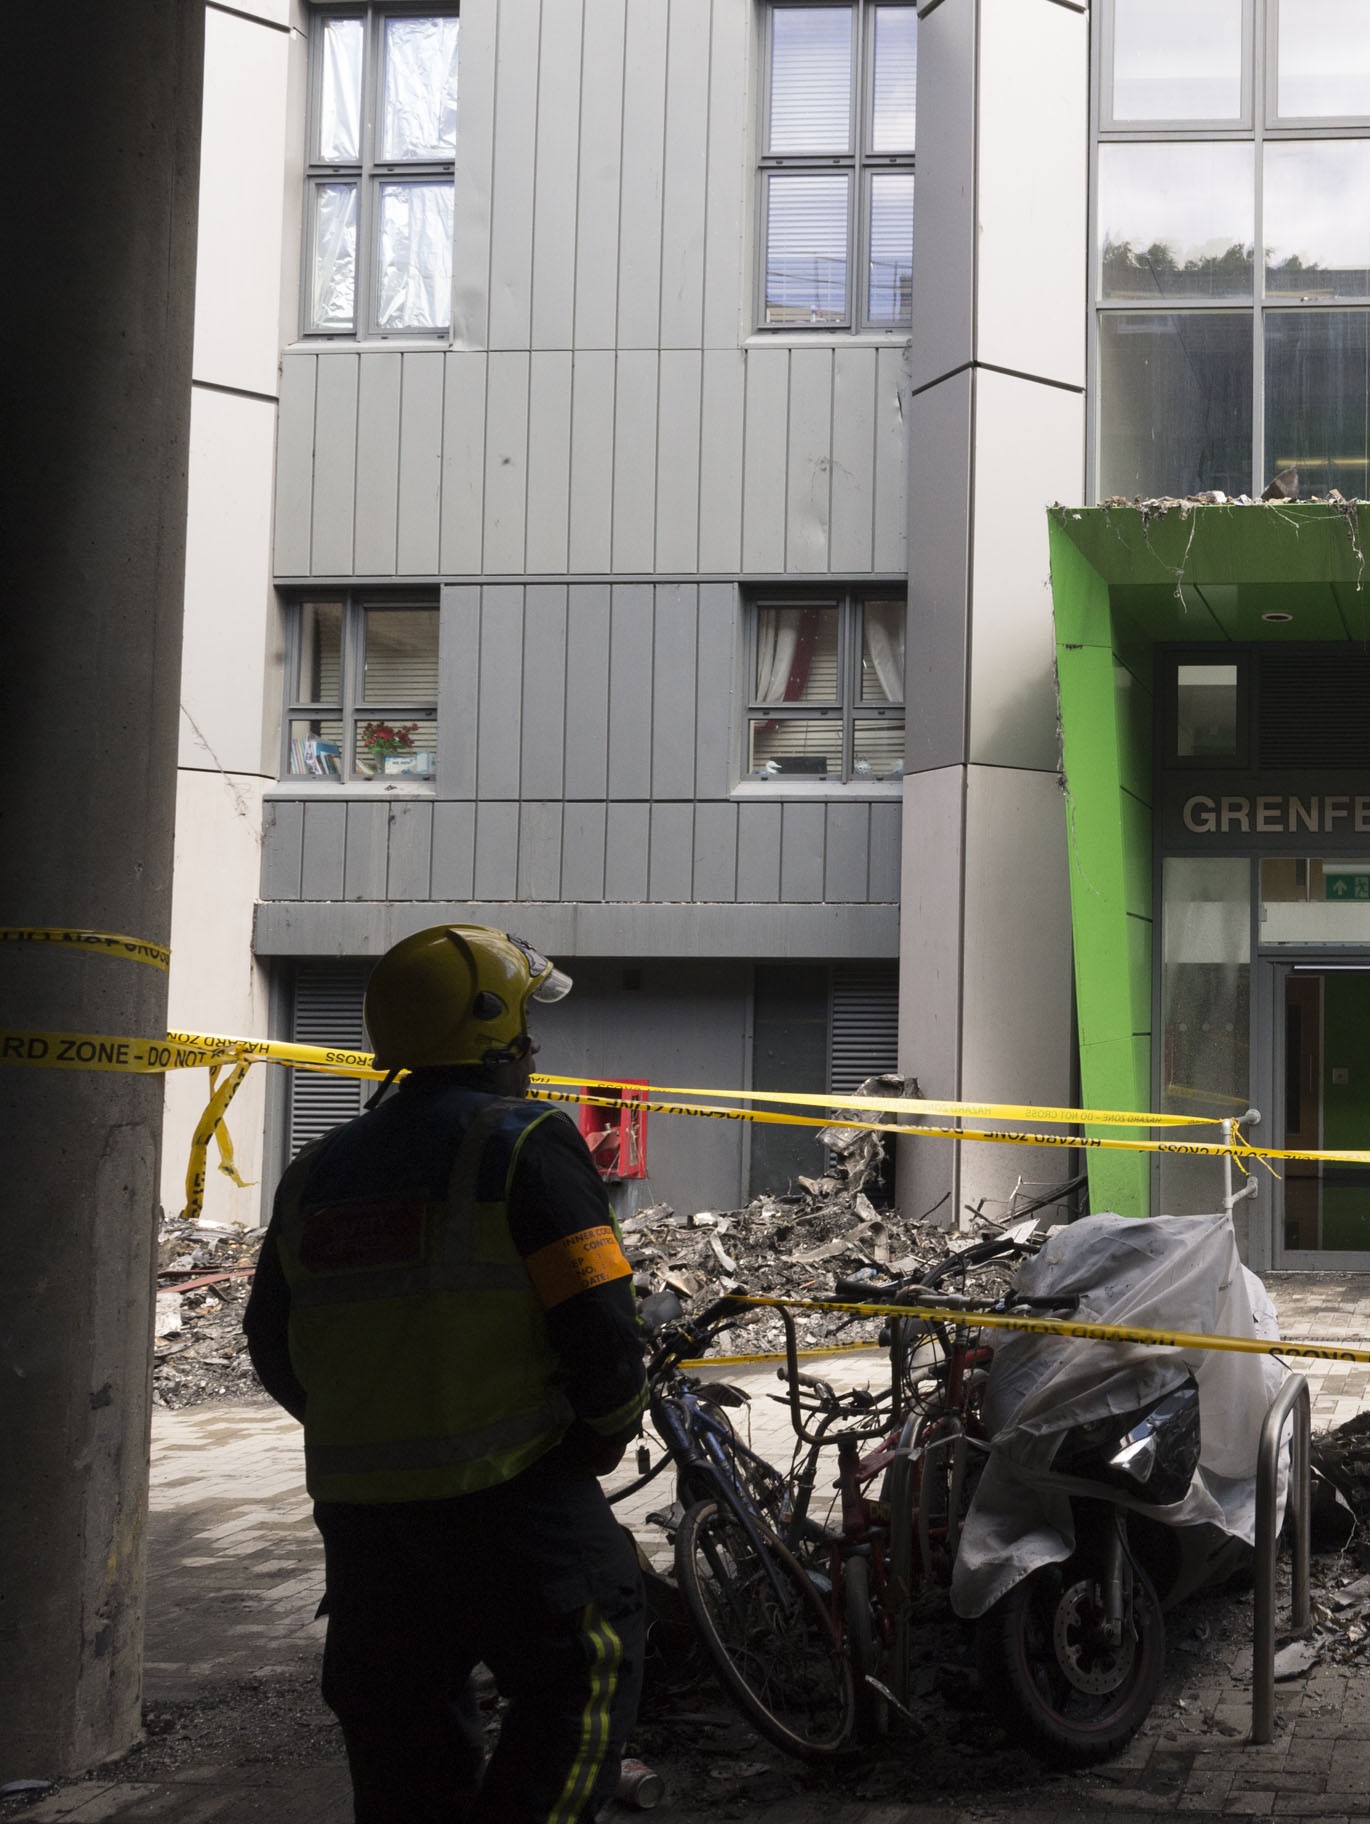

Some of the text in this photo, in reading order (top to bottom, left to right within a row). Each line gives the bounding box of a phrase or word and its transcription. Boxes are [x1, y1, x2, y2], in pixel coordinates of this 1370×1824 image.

[56, 1039, 130, 1065] ZONE
[148, 1046, 171, 1067] DO
[174, 1049, 206, 1068] NOT
